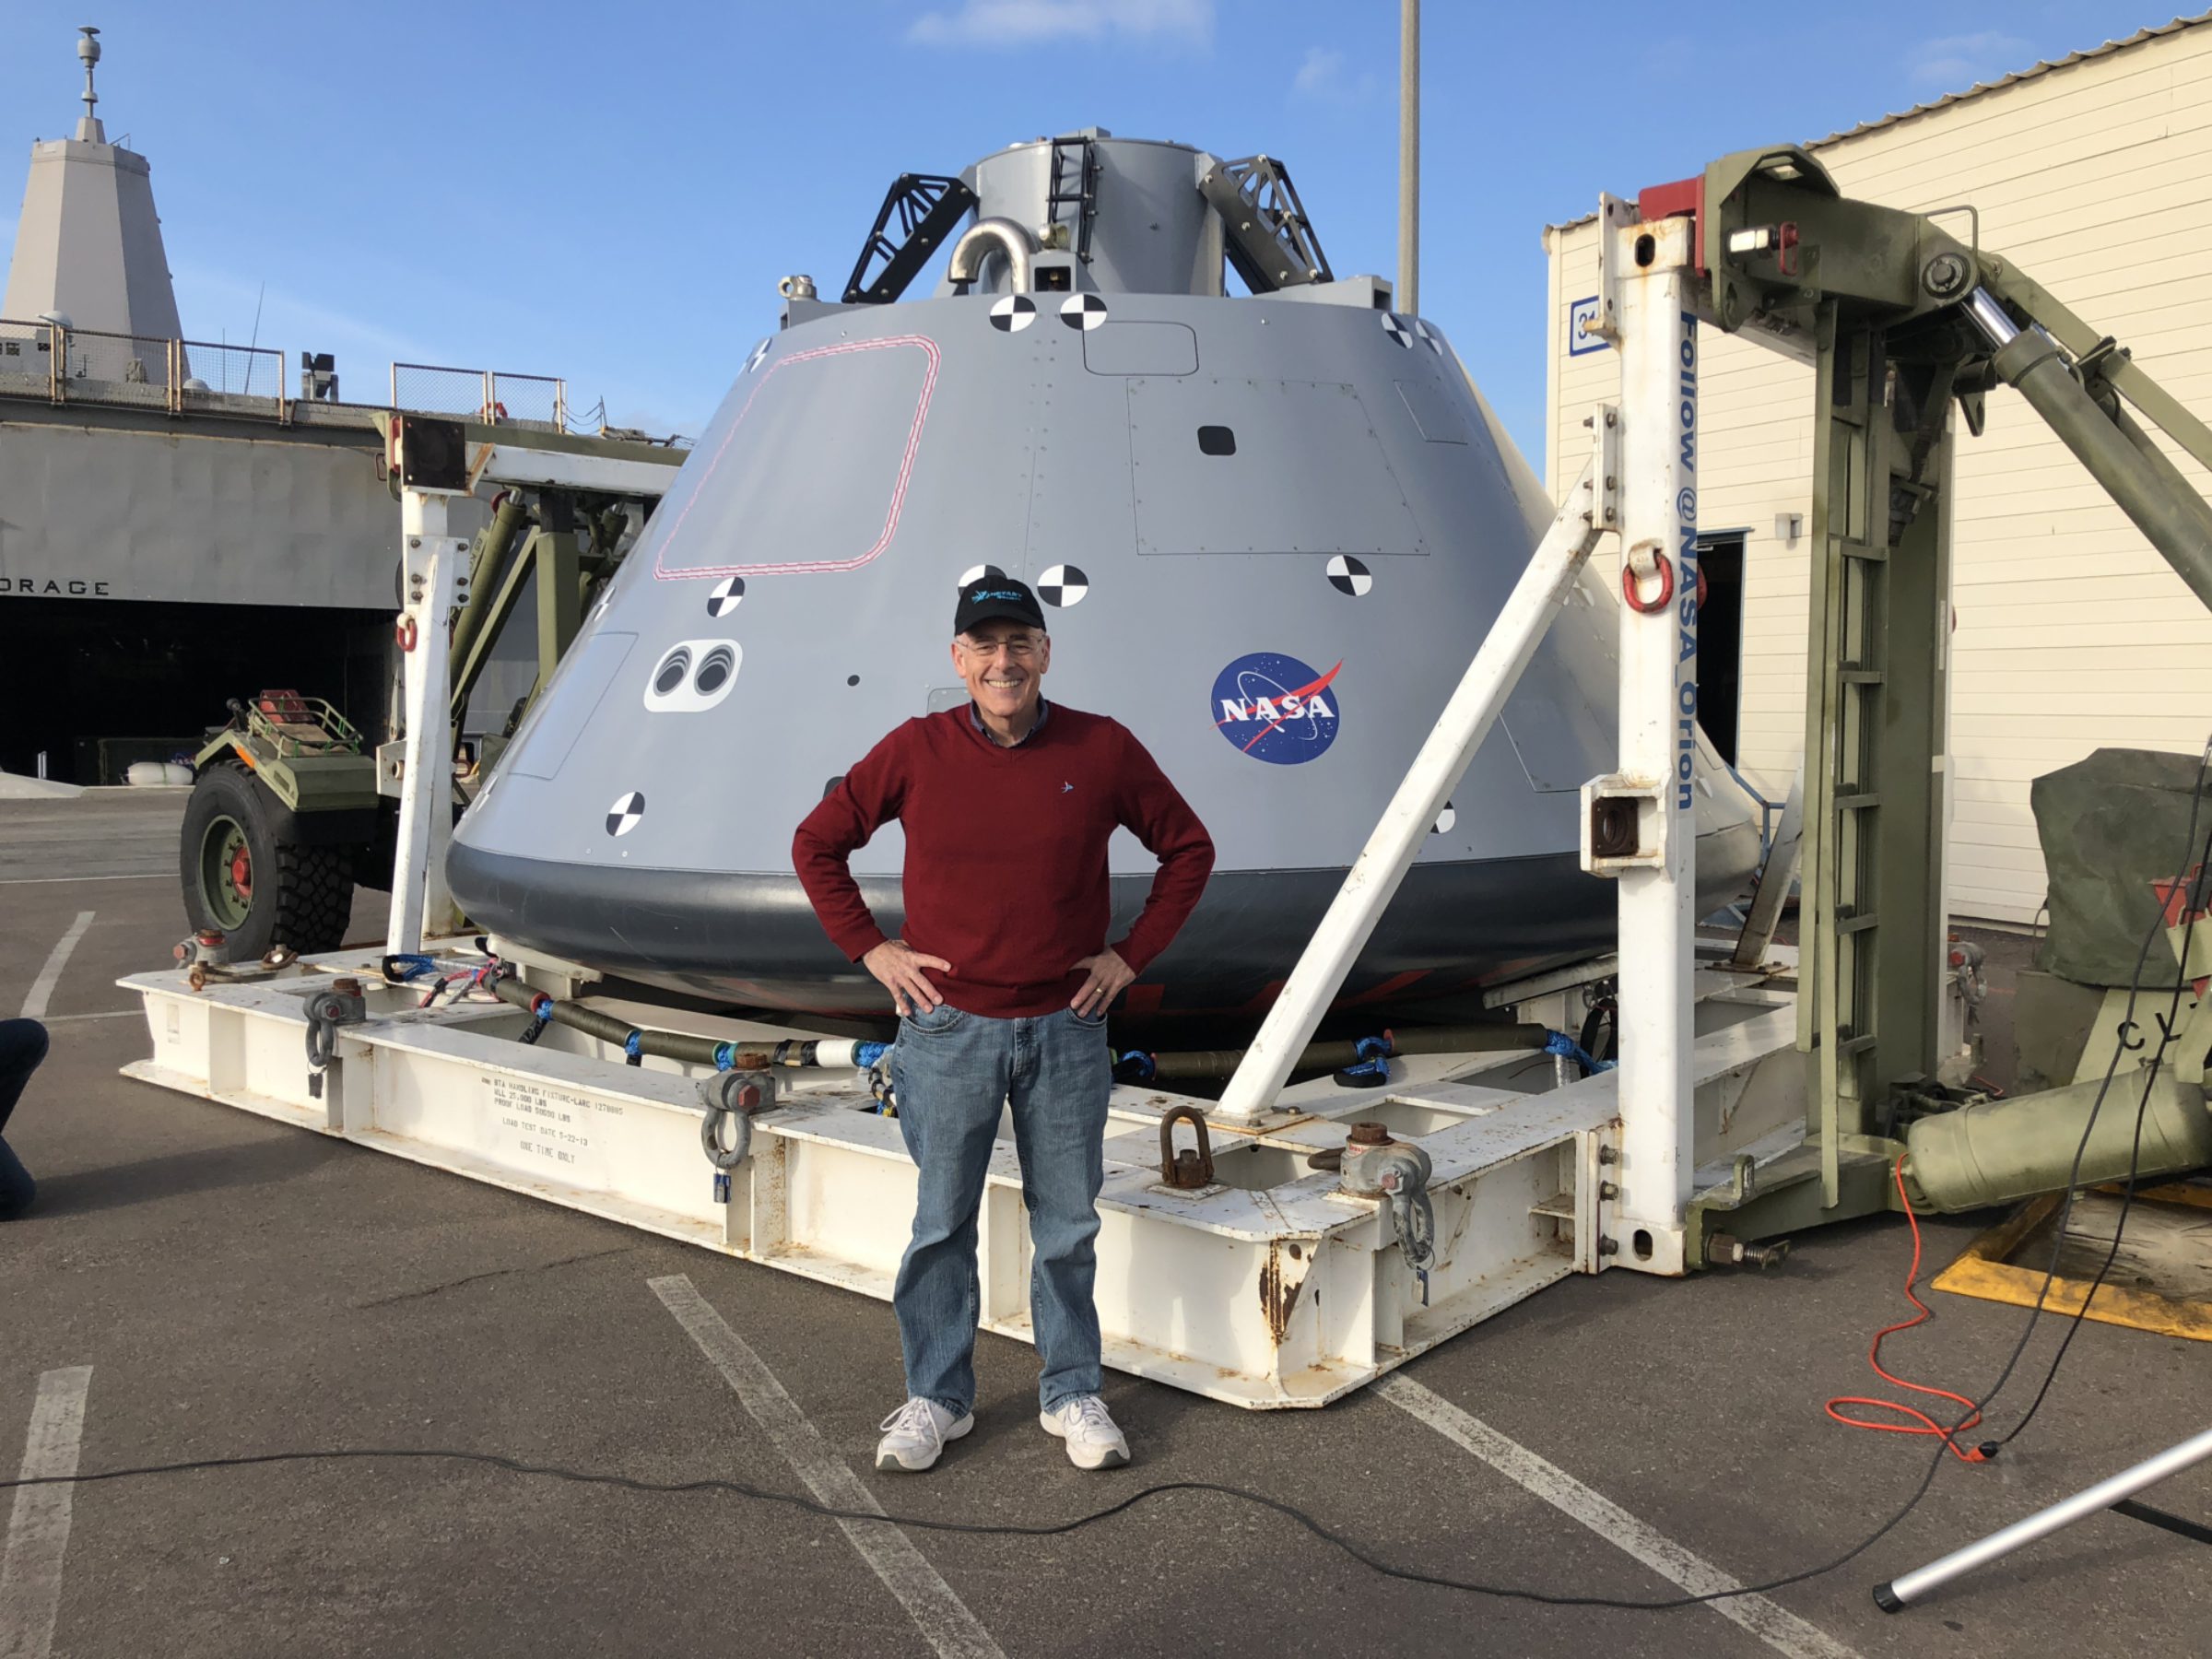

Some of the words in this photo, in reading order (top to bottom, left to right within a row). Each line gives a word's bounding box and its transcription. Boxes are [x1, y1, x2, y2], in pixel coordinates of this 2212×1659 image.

[1680, 311, 1696, 473] Follow
[1676, 487, 1697, 810] @NASA_Orion
[1220, 695, 1335, 723] NASA
[494, 1097, 512, 1108] PROOF
[516, 1102, 532, 1113] LOAD
[502, 1116, 518, 1127] LOAD
[522, 1122, 536, 1132] TEST
[540, 1126, 556, 1137] DATE
[520, 1140, 533, 1152] ONE
[536, 1144, 554, 1158] TIME
[558, 1150, 575, 1164] ONLY
